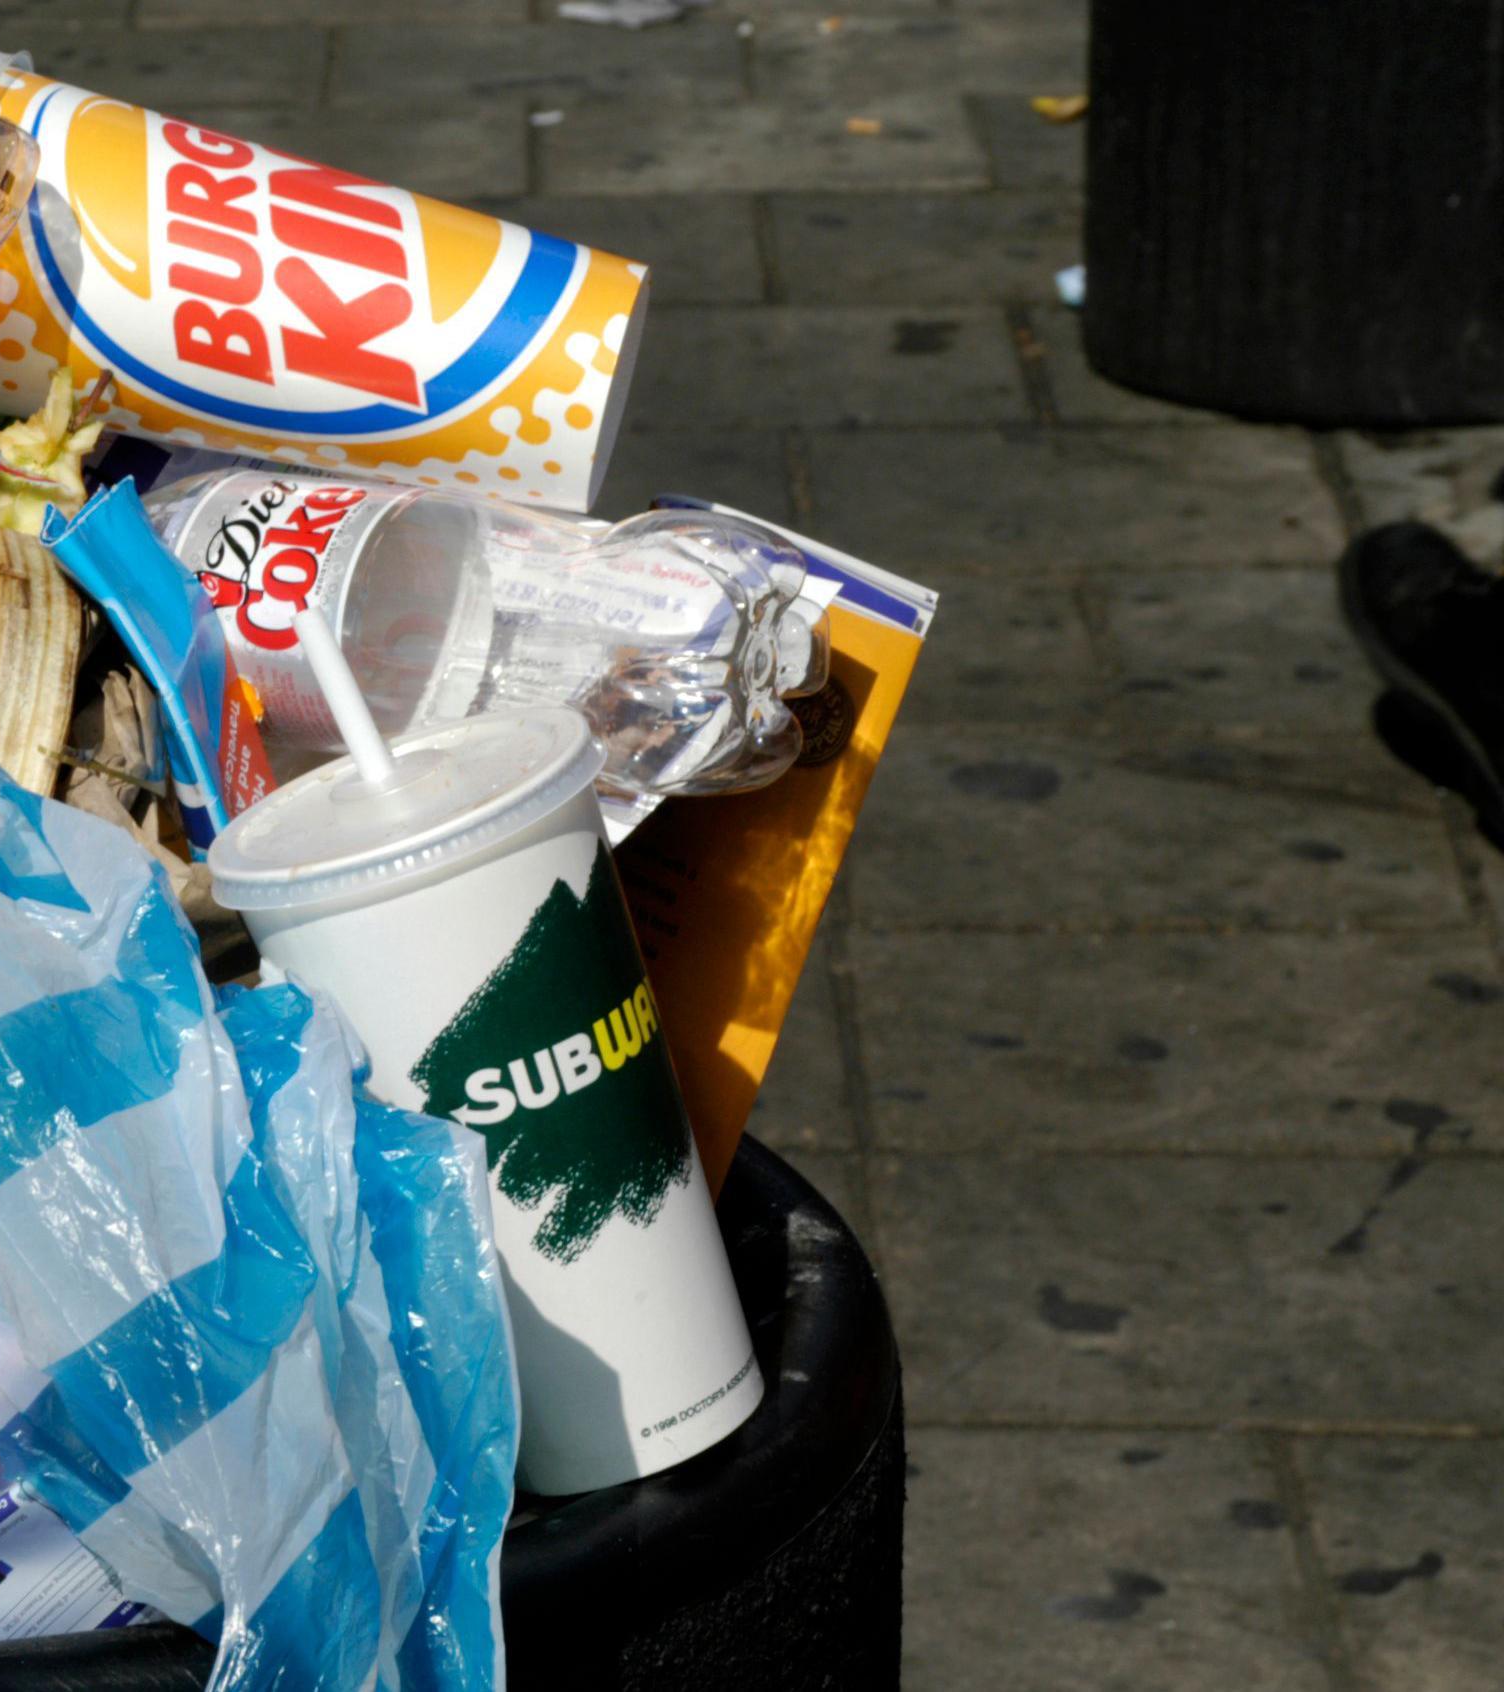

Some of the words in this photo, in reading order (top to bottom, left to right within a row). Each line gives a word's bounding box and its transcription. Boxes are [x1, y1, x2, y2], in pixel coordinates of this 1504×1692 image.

[162, 113, 275, 386] BURG
[267, 147, 421, 407] KIN
[206, 480, 299, 605] Diet
[236, 487, 368, 650] Coke
[449, 975, 657, 1127] SUBWA
